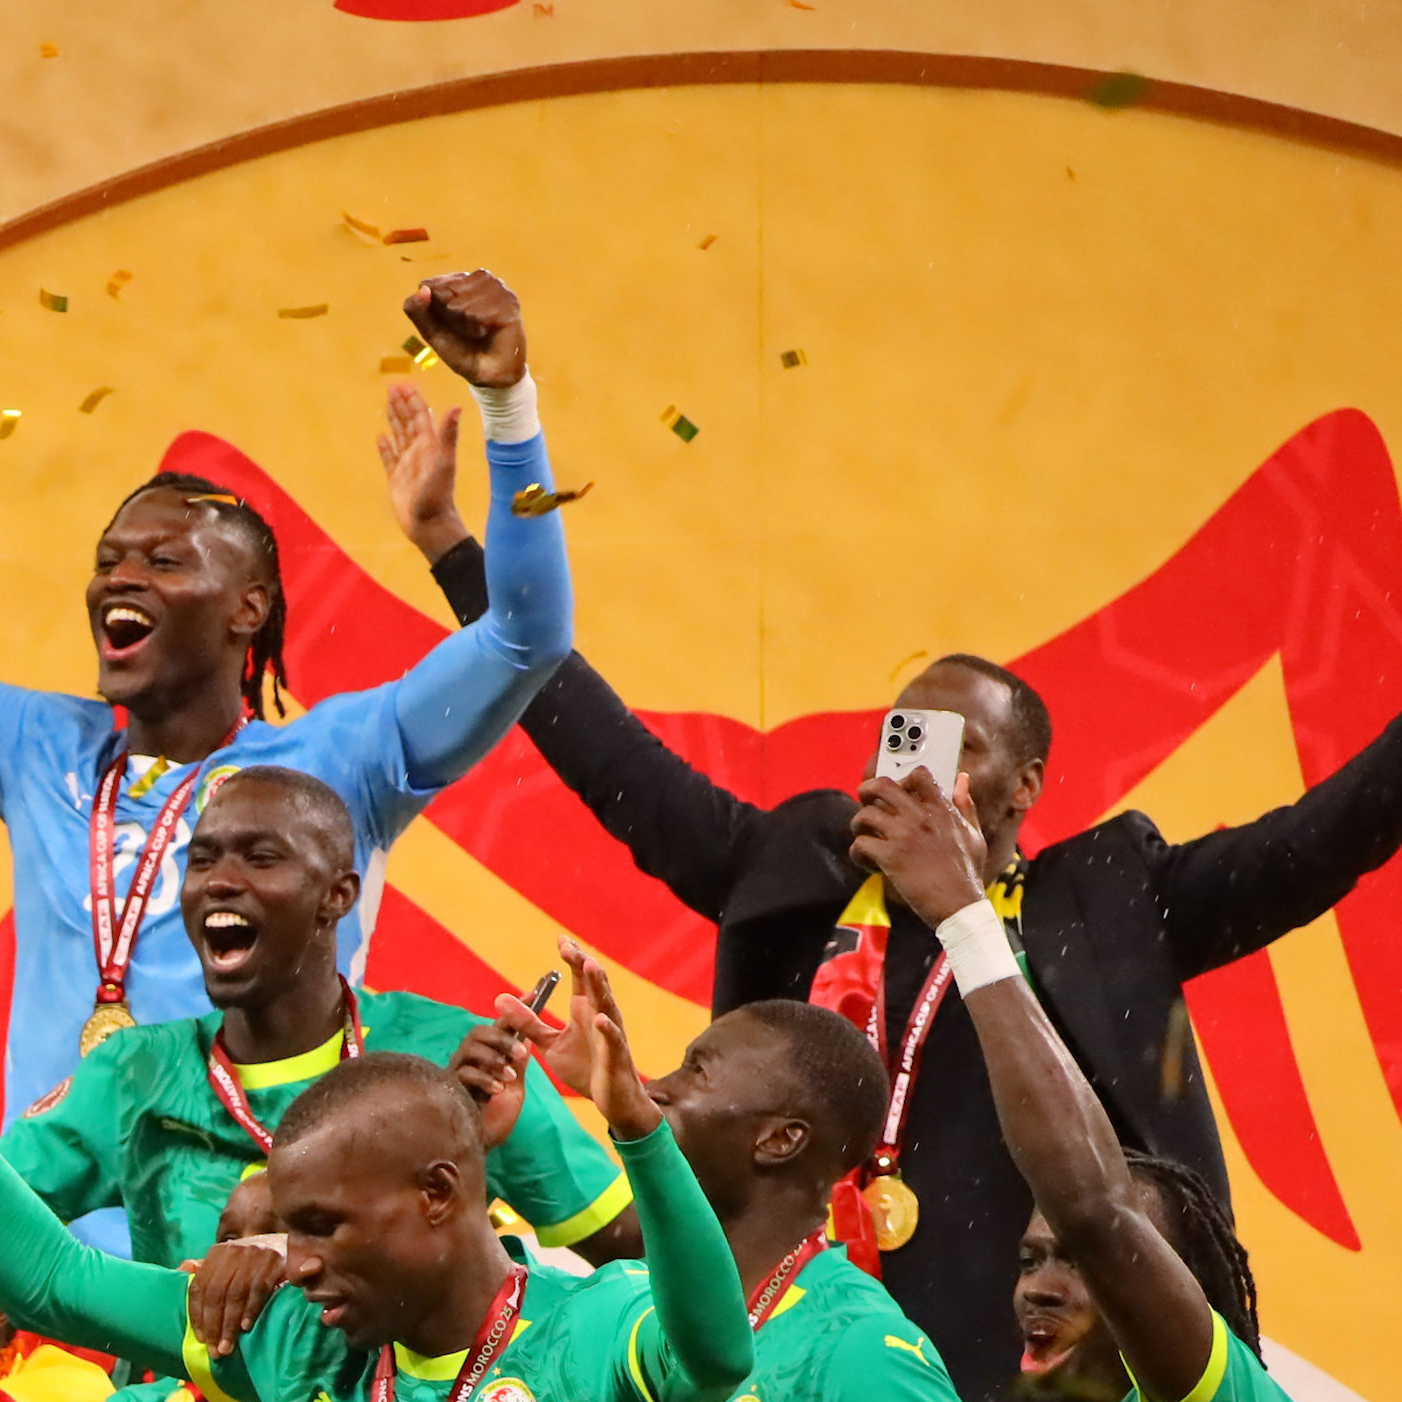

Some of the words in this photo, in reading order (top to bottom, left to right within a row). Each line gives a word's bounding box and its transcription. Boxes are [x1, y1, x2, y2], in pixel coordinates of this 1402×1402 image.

[753, 1254, 795, 1318] MOROCCO
[466, 1318, 506, 1387] MOROCCO
[501, 1306, 513, 1323] 25
